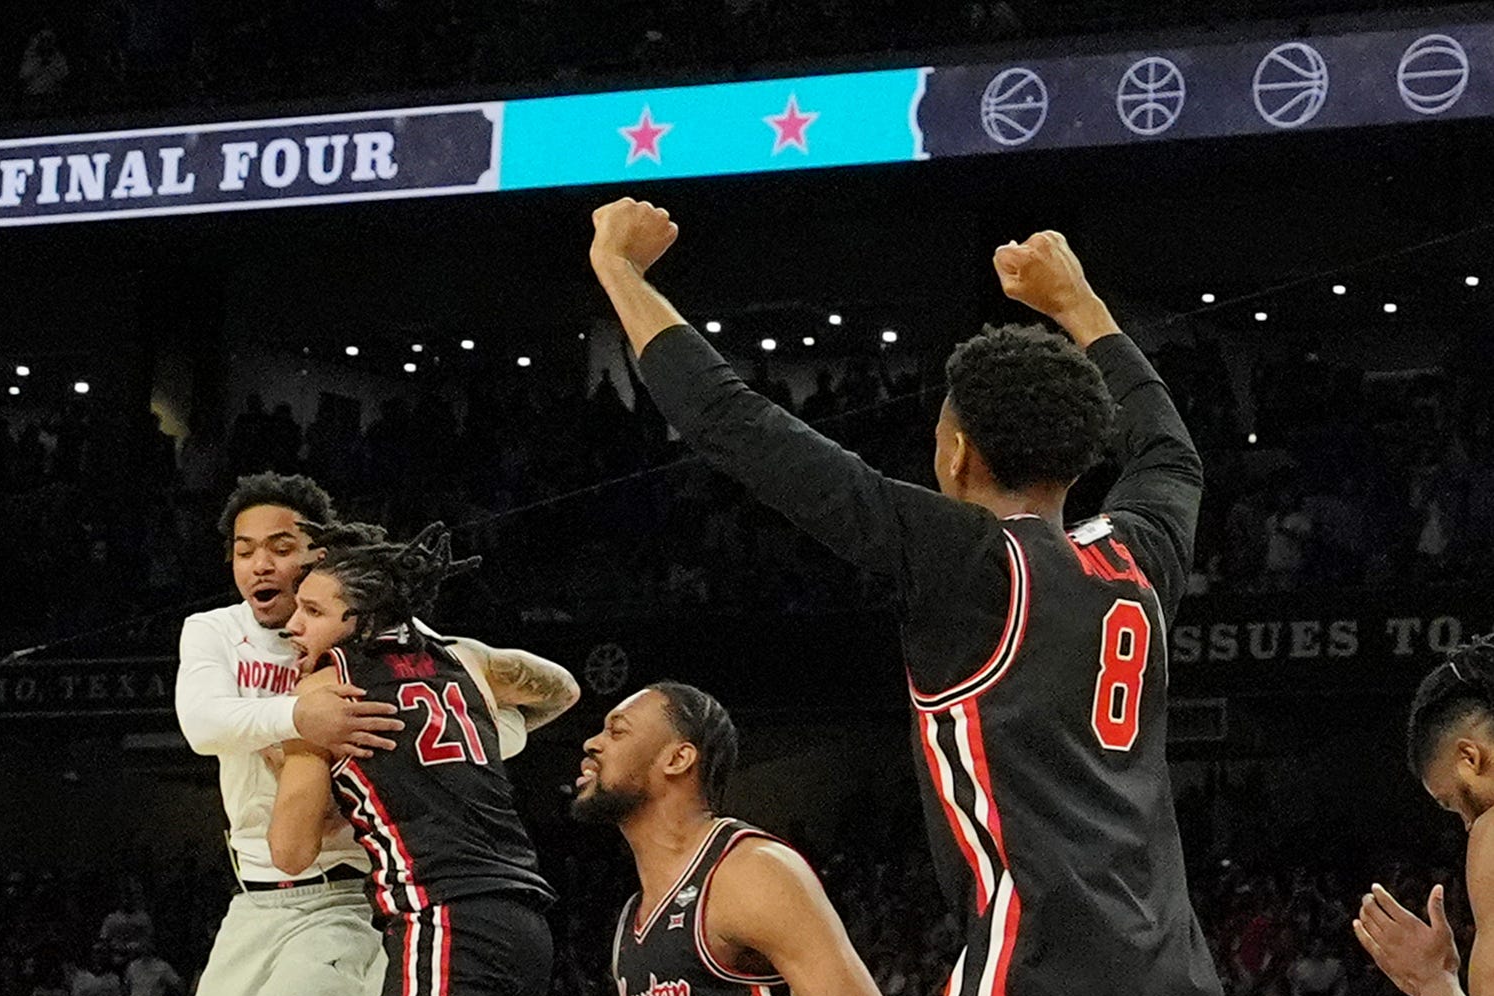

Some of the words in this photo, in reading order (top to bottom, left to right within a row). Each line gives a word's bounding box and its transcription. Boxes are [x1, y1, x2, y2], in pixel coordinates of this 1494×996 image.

[219, 131, 398, 191] FOUR
[1171, 620, 1358, 662] SSUES
[1385, 615, 1462, 656] TO
[58, 672, 168, 700] TEXA
[1091, 598, 1151, 751] 8
[397, 682, 488, 766] 21
